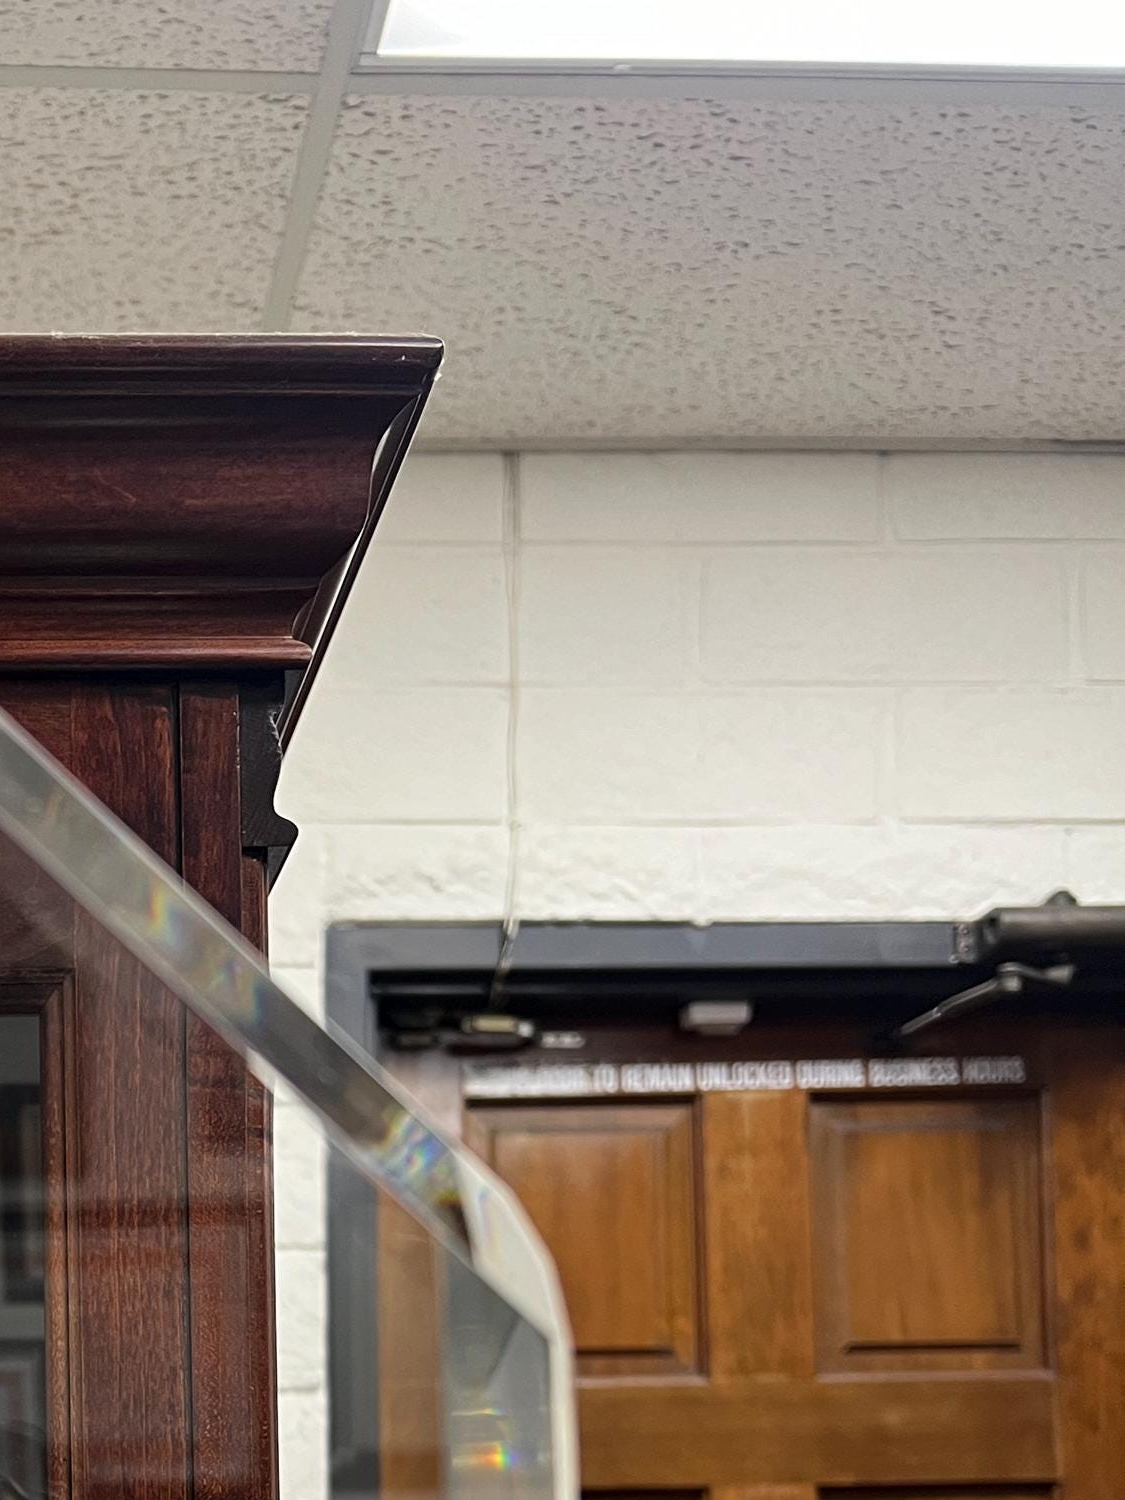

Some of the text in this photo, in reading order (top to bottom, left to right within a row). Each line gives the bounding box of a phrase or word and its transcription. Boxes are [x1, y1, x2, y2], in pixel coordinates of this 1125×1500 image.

[592, 1063, 620, 1094] TO
[621, 1062, 695, 1093] REMAIN
[697, 1060, 794, 1090] UNLOCKED
[795, 1058, 866, 1088] DURING
[868, 1056, 961, 1086] BUSINESS
[962, 1055, 1025, 1084] HOURS
